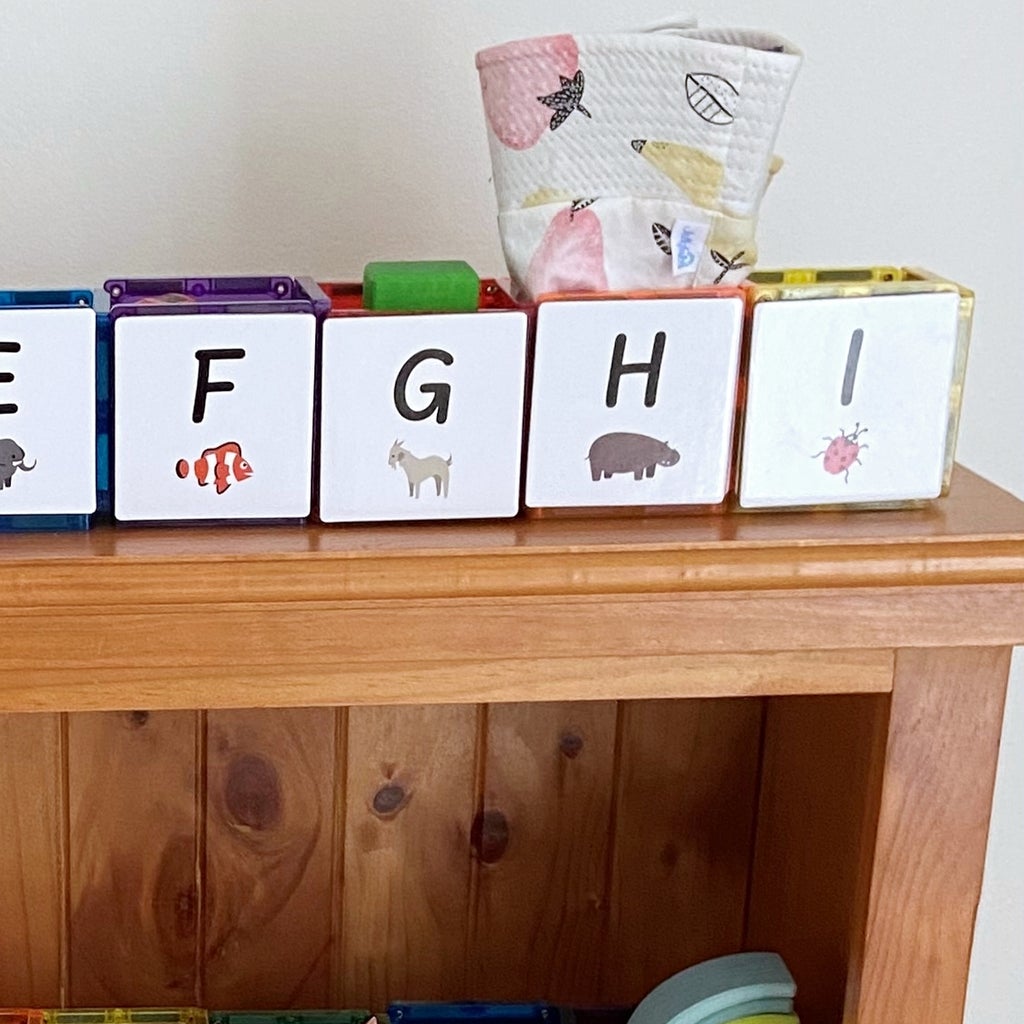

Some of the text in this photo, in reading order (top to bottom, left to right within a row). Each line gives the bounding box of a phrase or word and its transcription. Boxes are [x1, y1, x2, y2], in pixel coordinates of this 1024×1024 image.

[191, 348, 246, 424] F
[393, 348, 454, 425] G
[605, 331, 667, 408] H
[840, 328, 865, 407] I
